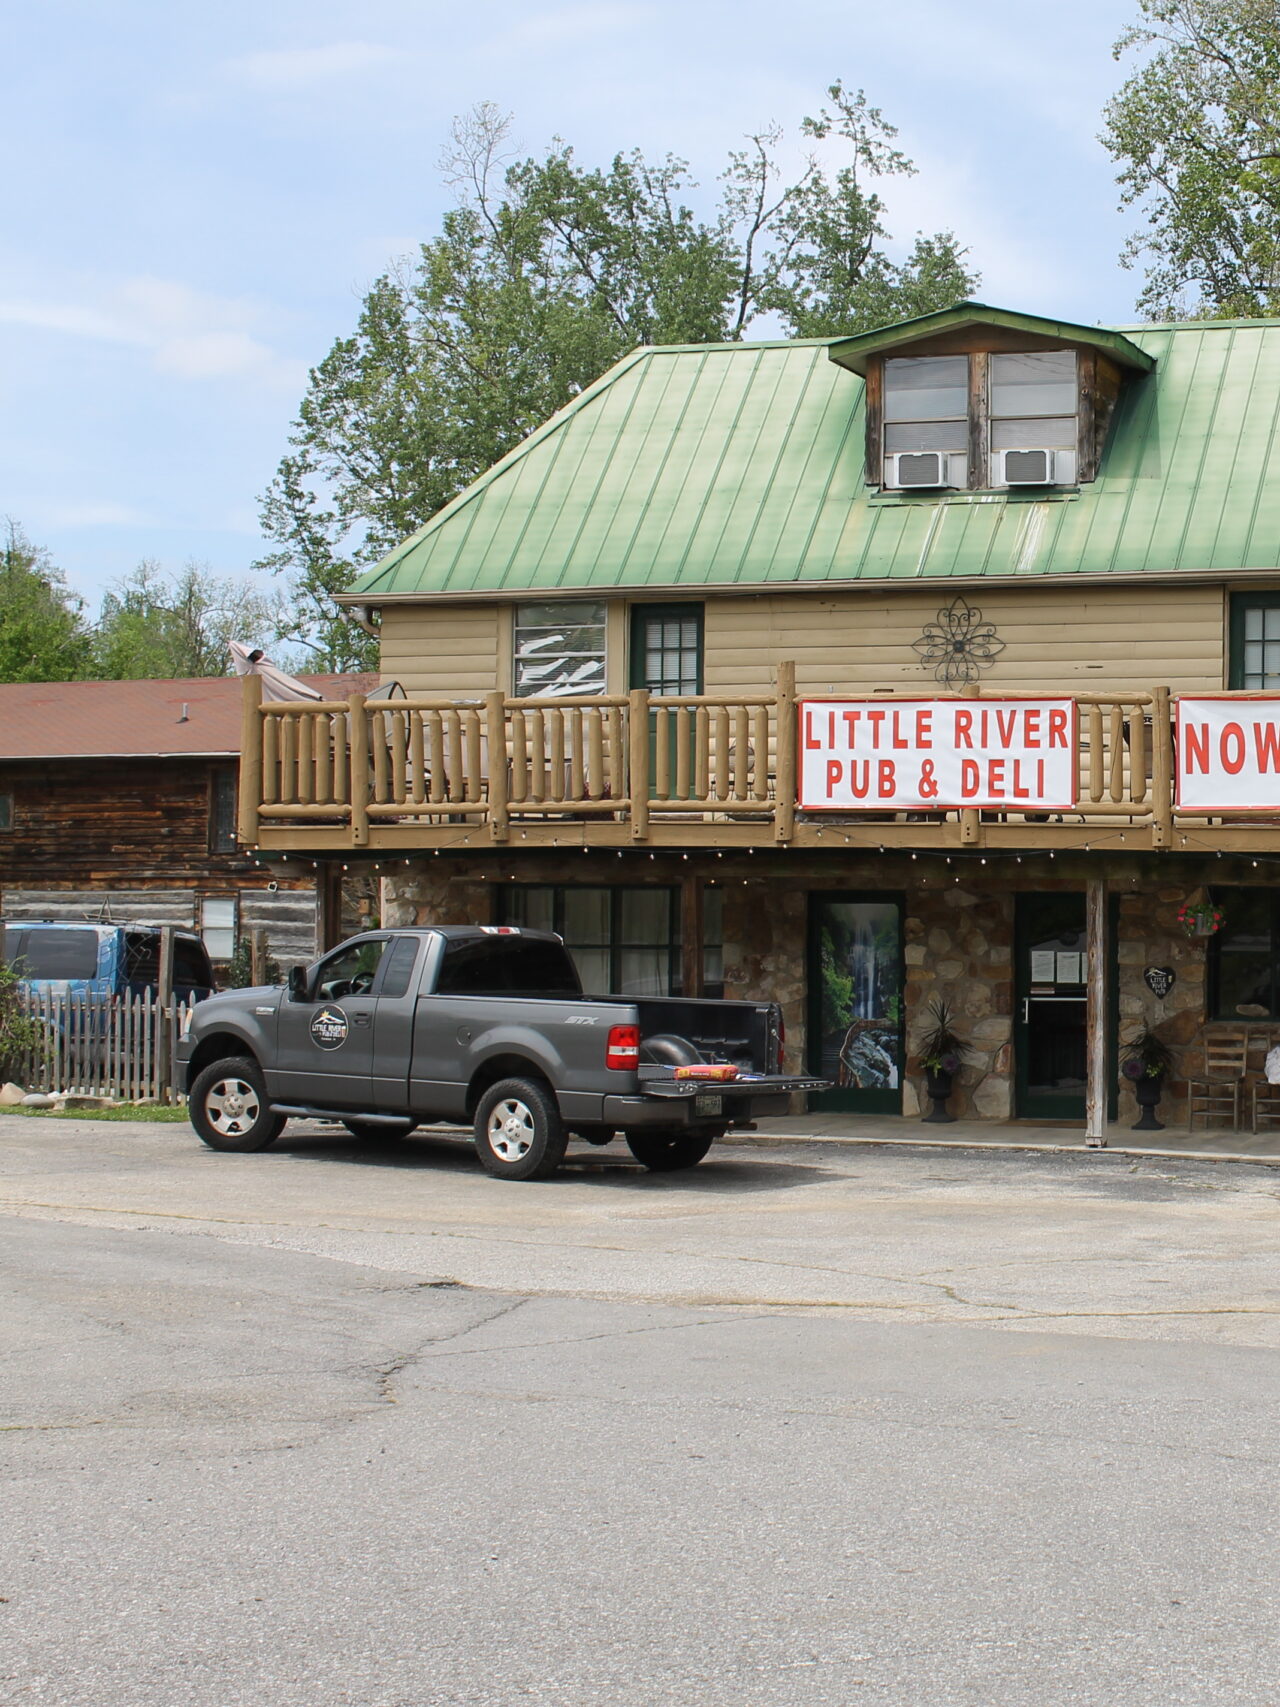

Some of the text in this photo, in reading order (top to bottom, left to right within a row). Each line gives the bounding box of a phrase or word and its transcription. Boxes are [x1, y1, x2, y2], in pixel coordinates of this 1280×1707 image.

[805, 709, 1069, 750] LITTLE RIVER
[826, 759, 1044, 799] PUB & DELI
